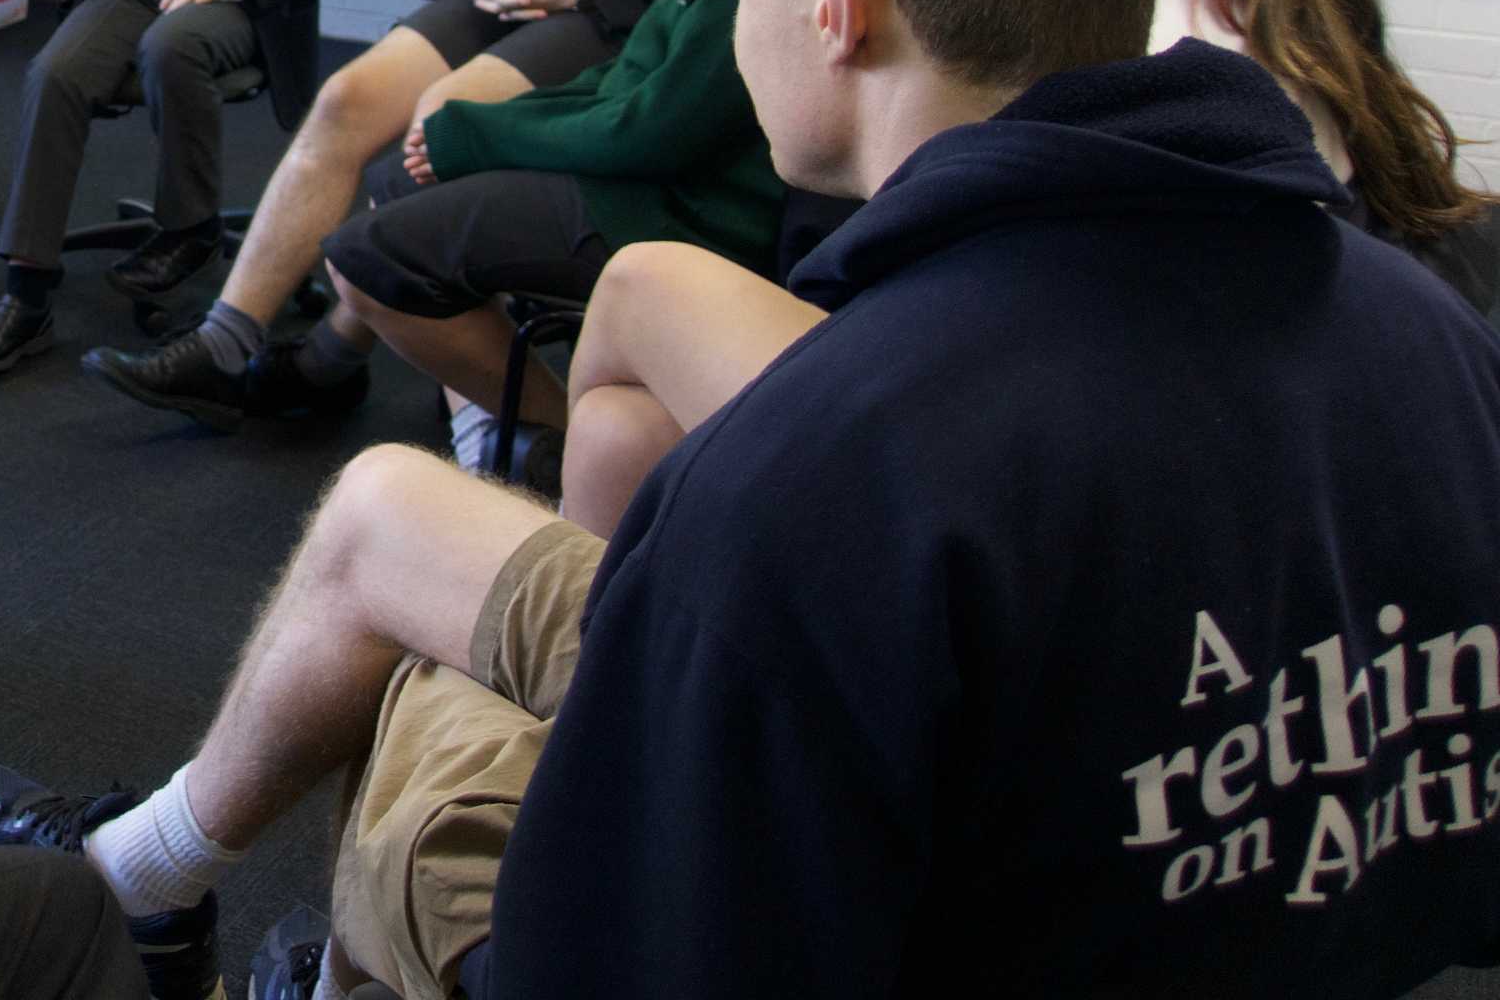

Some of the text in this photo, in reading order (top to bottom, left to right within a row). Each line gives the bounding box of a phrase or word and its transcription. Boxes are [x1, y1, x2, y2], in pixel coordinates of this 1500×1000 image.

[1180, 609, 1253, 706] A
[1121, 603, 1500, 846] rethin
[1161, 816, 1275, 902] on
